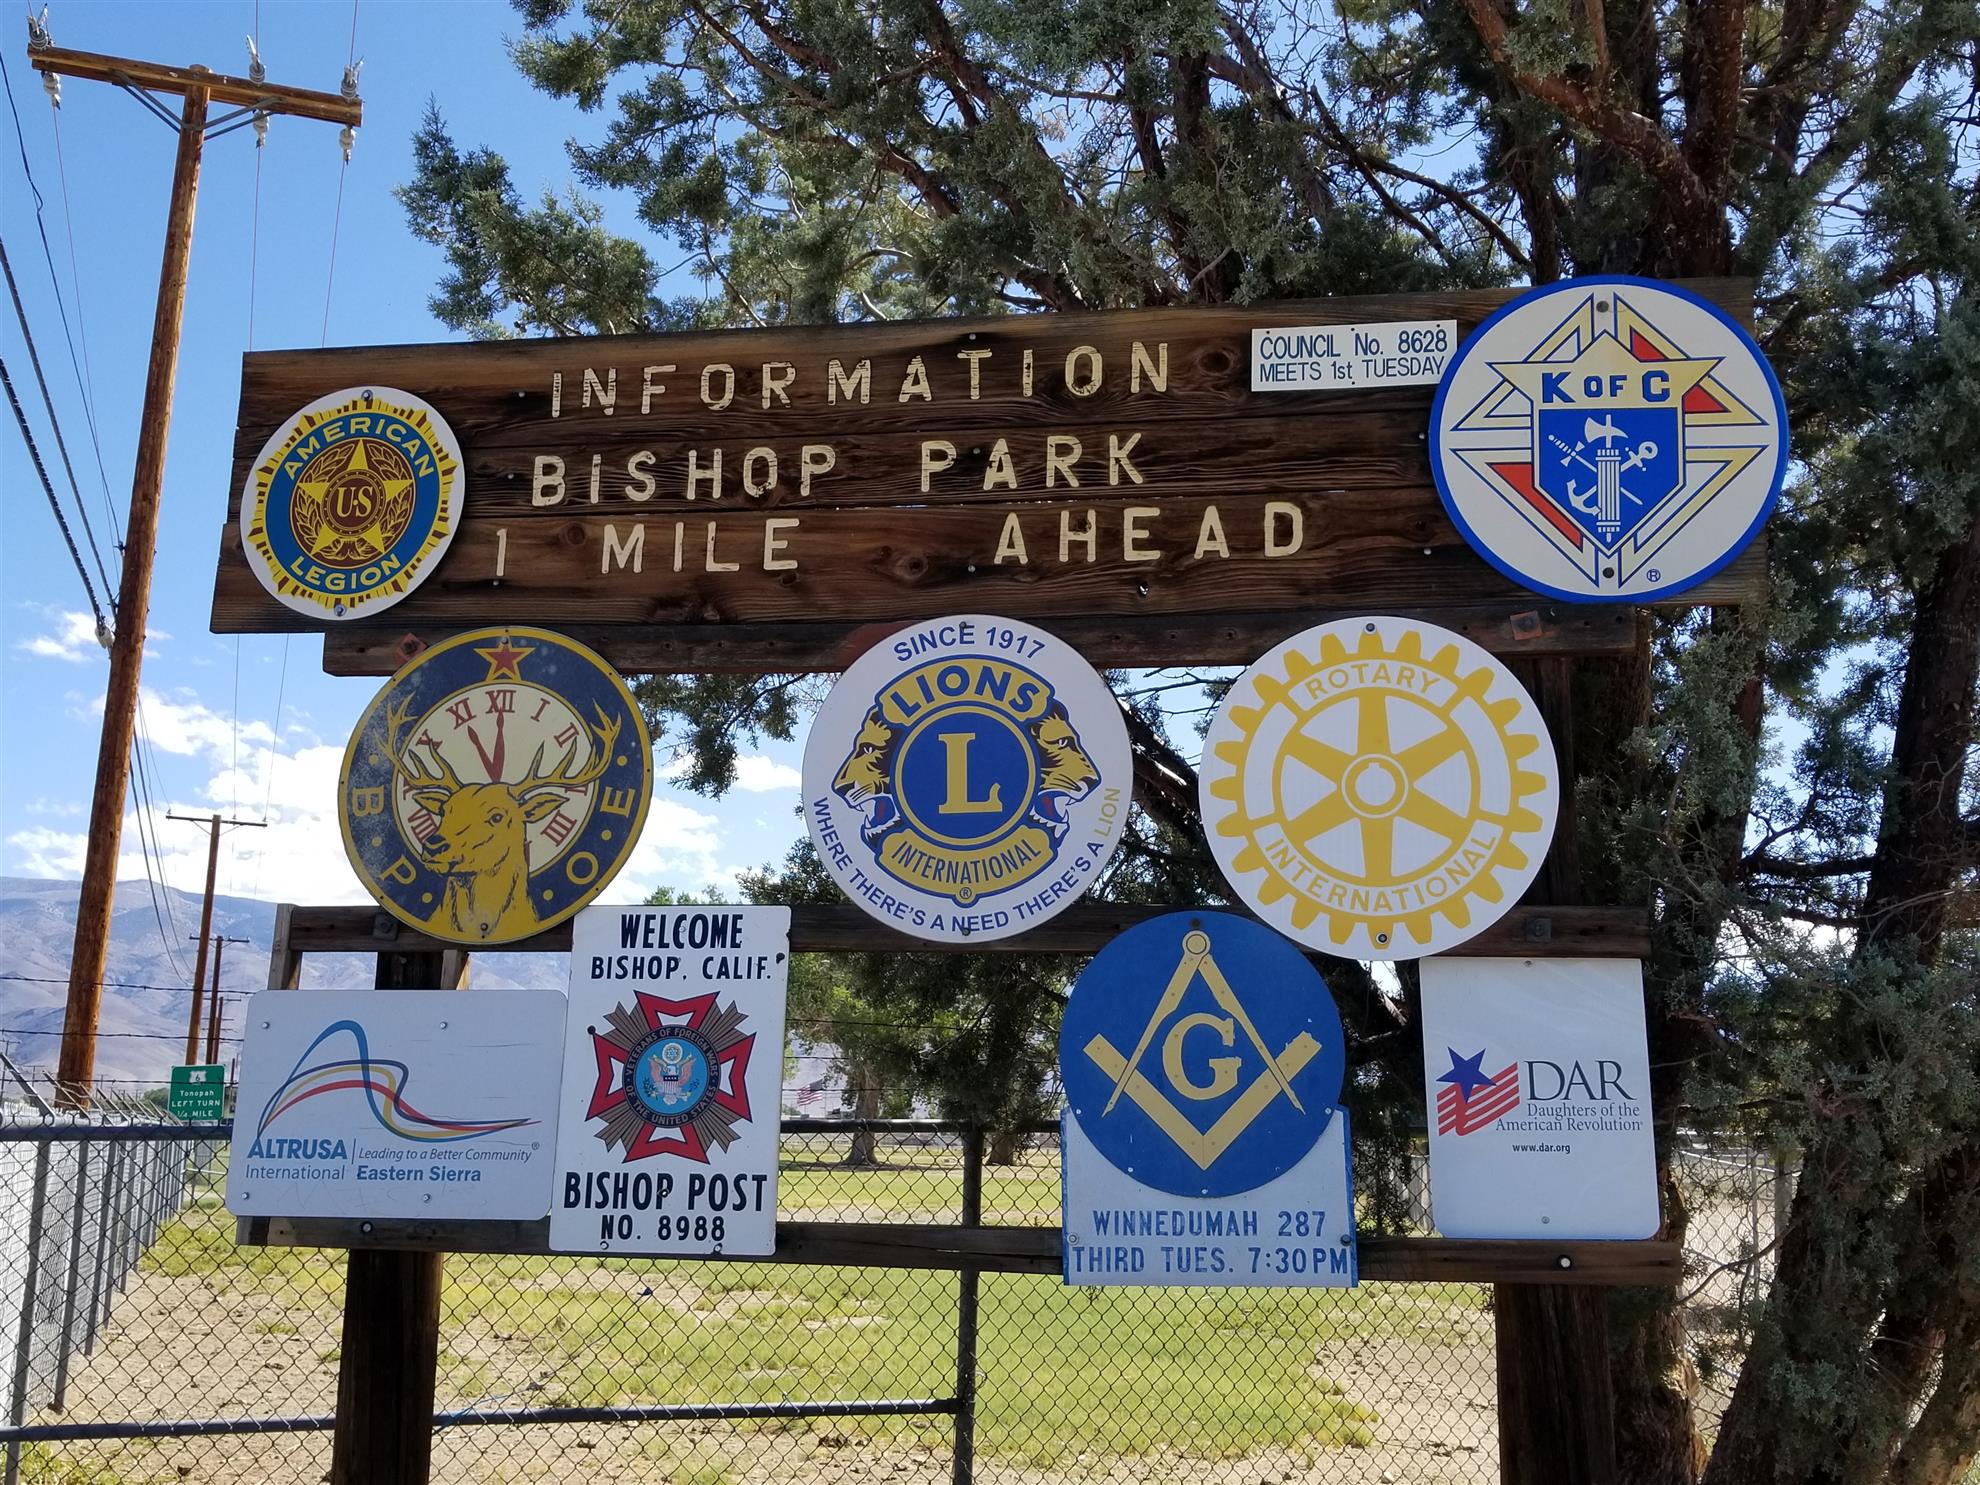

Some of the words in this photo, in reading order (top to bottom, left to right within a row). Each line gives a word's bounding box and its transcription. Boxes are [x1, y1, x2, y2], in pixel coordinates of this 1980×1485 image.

[1260, 333, 1341, 360] COUNCIL
[1354, 332, 1384, 356] No.
[1397, 329, 1448, 353] 8628
[551, 342, 1168, 418] INFORMATION
[1260, 361, 1321, 382] MEETS
[1330, 360, 1352, 380] 1st
[1362, 356, 1445, 378] TUESDAY
[1541, 371, 1576, 403] K
[1584, 374, 1627, 398] OF
[1642, 370, 1670, 402] C
[284, 417, 434, 480] AMERICAN
[532, 445, 836, 507] BISHOP
[921, 433, 1143, 492] PARK
[601, 518, 800, 573] MILE
[994, 502, 1304, 564] AHEAD
[290, 553, 401, 590] LEGION
[894, 624, 975, 662] SINCE
[986, 626, 1046, 660] 1917
[890, 665, 1040, 718] LIONS
[1305, 663, 1440, 700] ROTARY
[445, 697, 477, 730] XI
[485, 689, 517, 714] XII
[938, 732, 1003, 814] L
[1094, 788, 1121, 837] LION
[813, 797, 853, 871] WHERE
[1086, 841, 1104, 857] A
[891, 838, 1042, 884] INTERNATIONAL
[1265, 836, 1496, 913] INTERNATIONAL
[850, 868, 926, 926] THERE'S
[1012, 856, 1092, 920] THERE'S
[621, 914, 744, 949] WELCOME
[930, 914, 945, 931] A
[952, 911, 1009, 933] NEED
[702, 955, 771, 980] CALIF.
[625, 1032, 658, 1076] VETERANS
[660, 1027, 672, 1036] OF
[674, 1027, 710, 1051] FOREIGN
[706, 1051, 719, 1077] WARS
[1162, 1012, 1242, 1100] G
[1524, 1060, 1637, 1101] DAR
[192, 1109, 213, 1117] MILE
[197, 1099, 220, 1107] TURN
[625, 1085, 636, 1098] OF
[632, 1102, 649, 1118] THE
[651, 1113, 689, 1125] UNITED
[690, 1085, 717, 1116] STATES
[1527, 1103, 1597, 1120] Daughters
[1601, 1102, 1614, 1117] of
[1619, 1102, 1640, 1117] the
[1495, 1117, 1562, 1131] American
[247, 1138, 348, 1160] ALTRUSA
[358, 1147, 403, 1161] Leading
[406, 1149, 417, 1160] to
[420, 1150, 427, 1160] a
[430, 1148, 463, 1160] Better
[1512, 1143, 1571, 1154] www.dar.org
[245, 1164, 345, 1180] International
[357, 1165, 424, 1180] Eastern
[429, 1165, 481, 1181] Sierra
[564, 1171, 673, 1210] BISHOP
[688, 1172, 768, 1212] POST
[601, 1214, 642, 1241] NO.
[658, 1214, 726, 1241] 8988
[1092, 1210, 1258, 1237] WINNEDUMAH
[1277, 1210, 1326, 1237] 287
[1072, 1247, 1145, 1273] THIRD
[1160, 1247, 1234, 1273] TUES.
